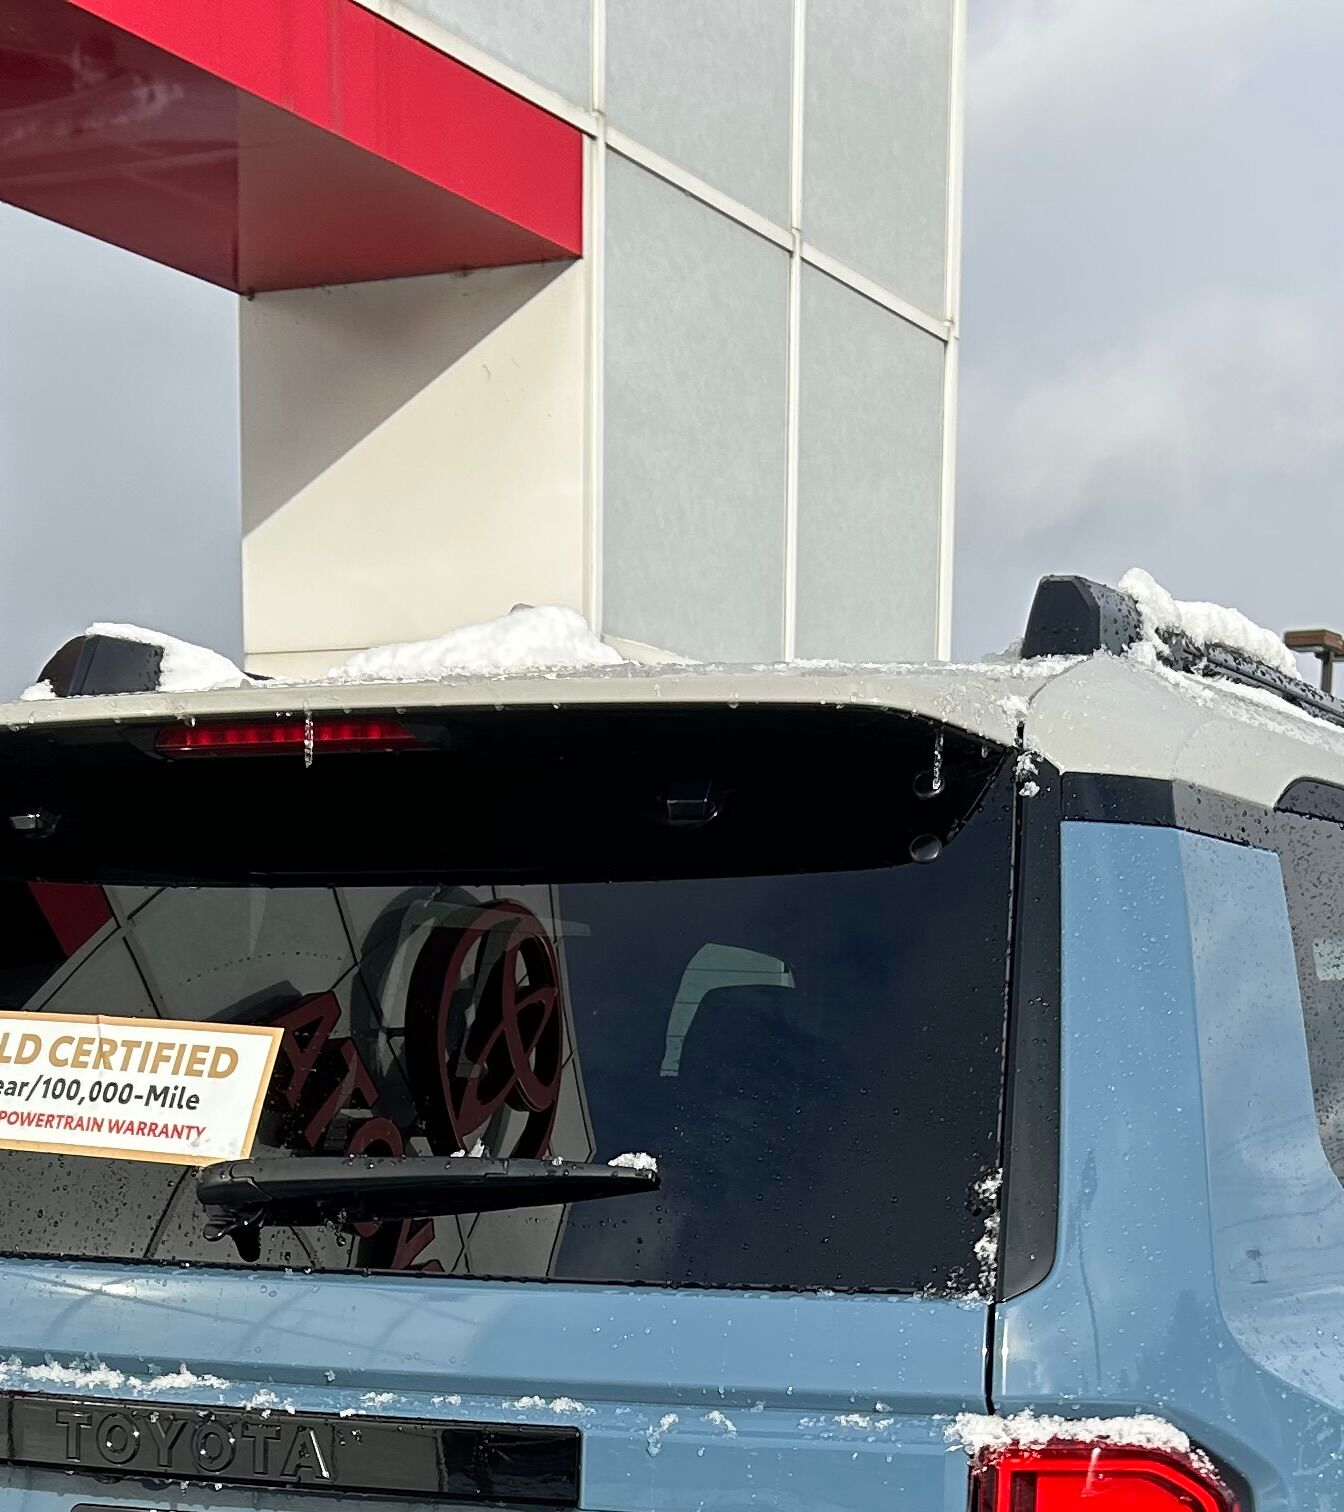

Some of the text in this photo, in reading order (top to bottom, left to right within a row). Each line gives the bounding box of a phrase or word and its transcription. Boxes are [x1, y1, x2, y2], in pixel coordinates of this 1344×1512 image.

[48, 1035, 239, 1079] CERTIFIED
[107, 1118, 207, 1140] WARRANTY
[56, 1410, 330, 1480] TOYOTA
